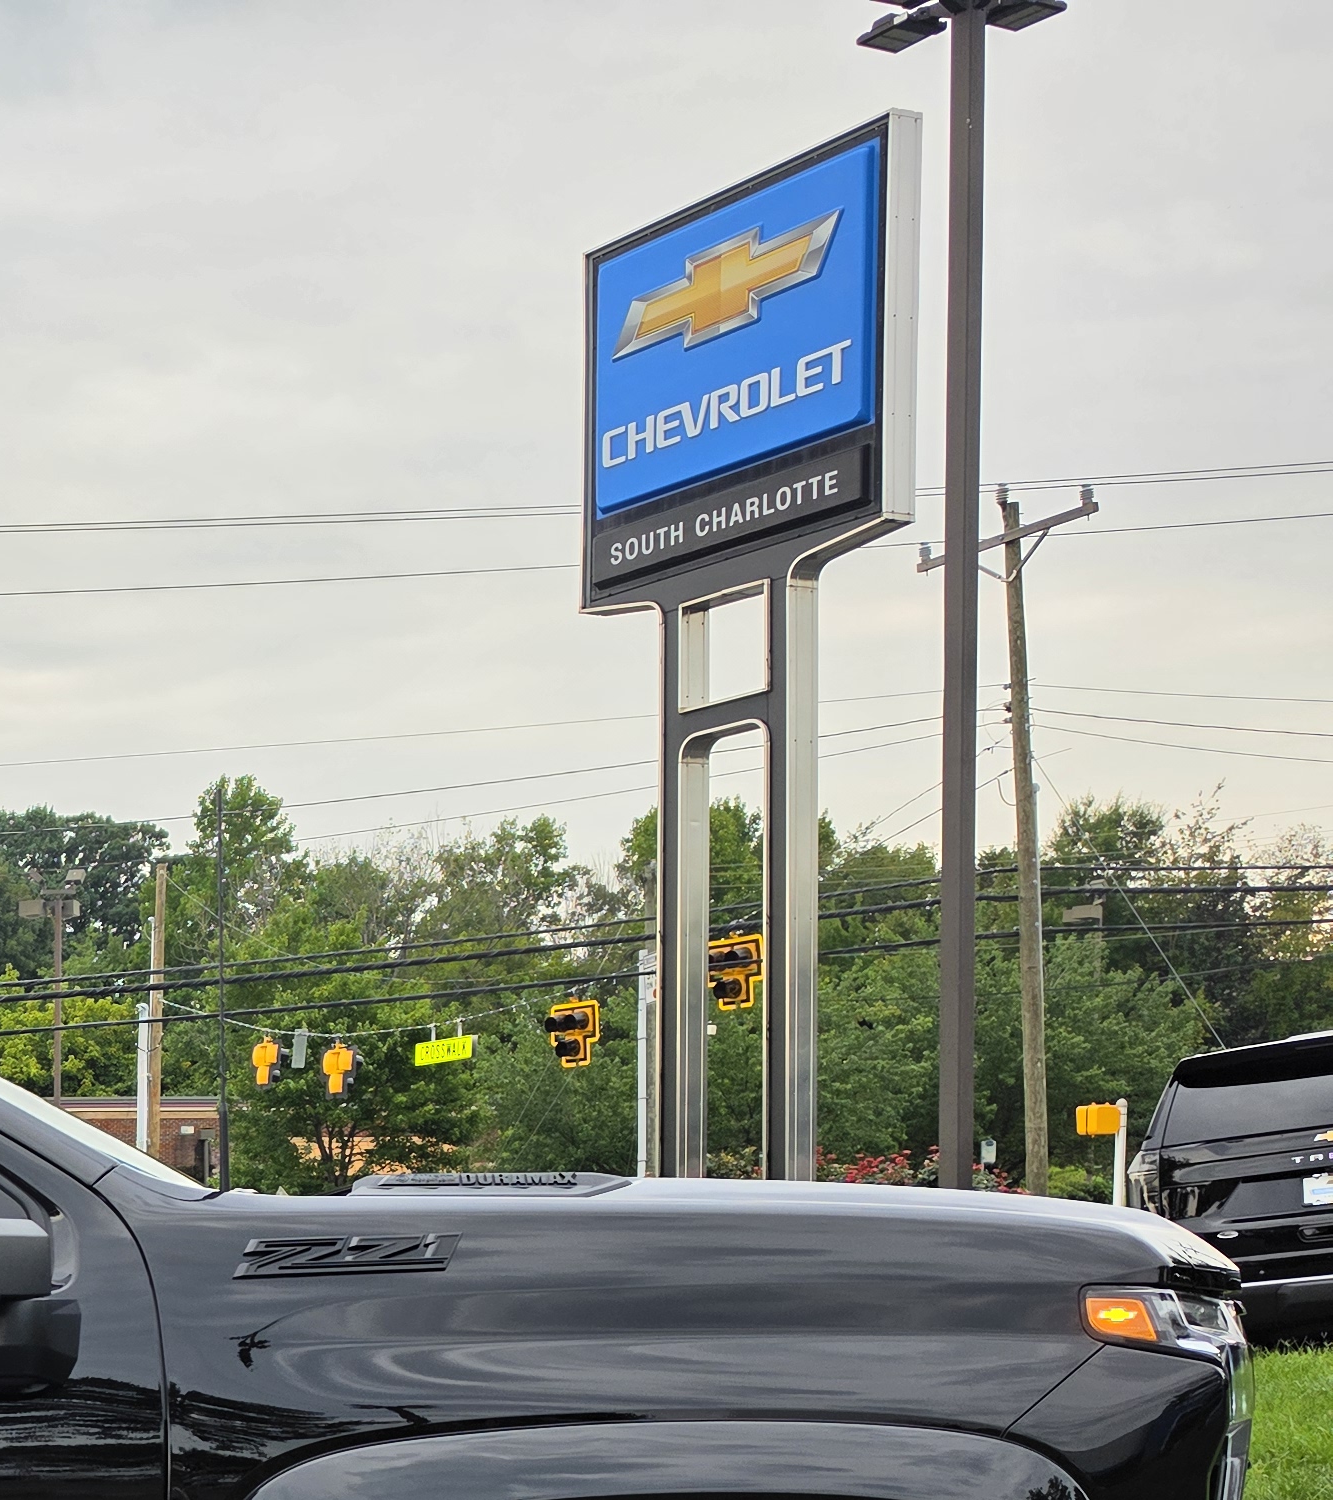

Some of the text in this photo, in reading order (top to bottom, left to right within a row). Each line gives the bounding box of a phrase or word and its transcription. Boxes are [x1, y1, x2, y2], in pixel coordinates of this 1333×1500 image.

[602, 338, 853, 469] CHEVROLET
[610, 470, 839, 566] SOUTH CHARLOTTE
[420, 1040, 468, 1061] CROSSWALK
[459, 1172, 578, 1187] DURAMAX
[232, 1231, 463, 1281] Z71
